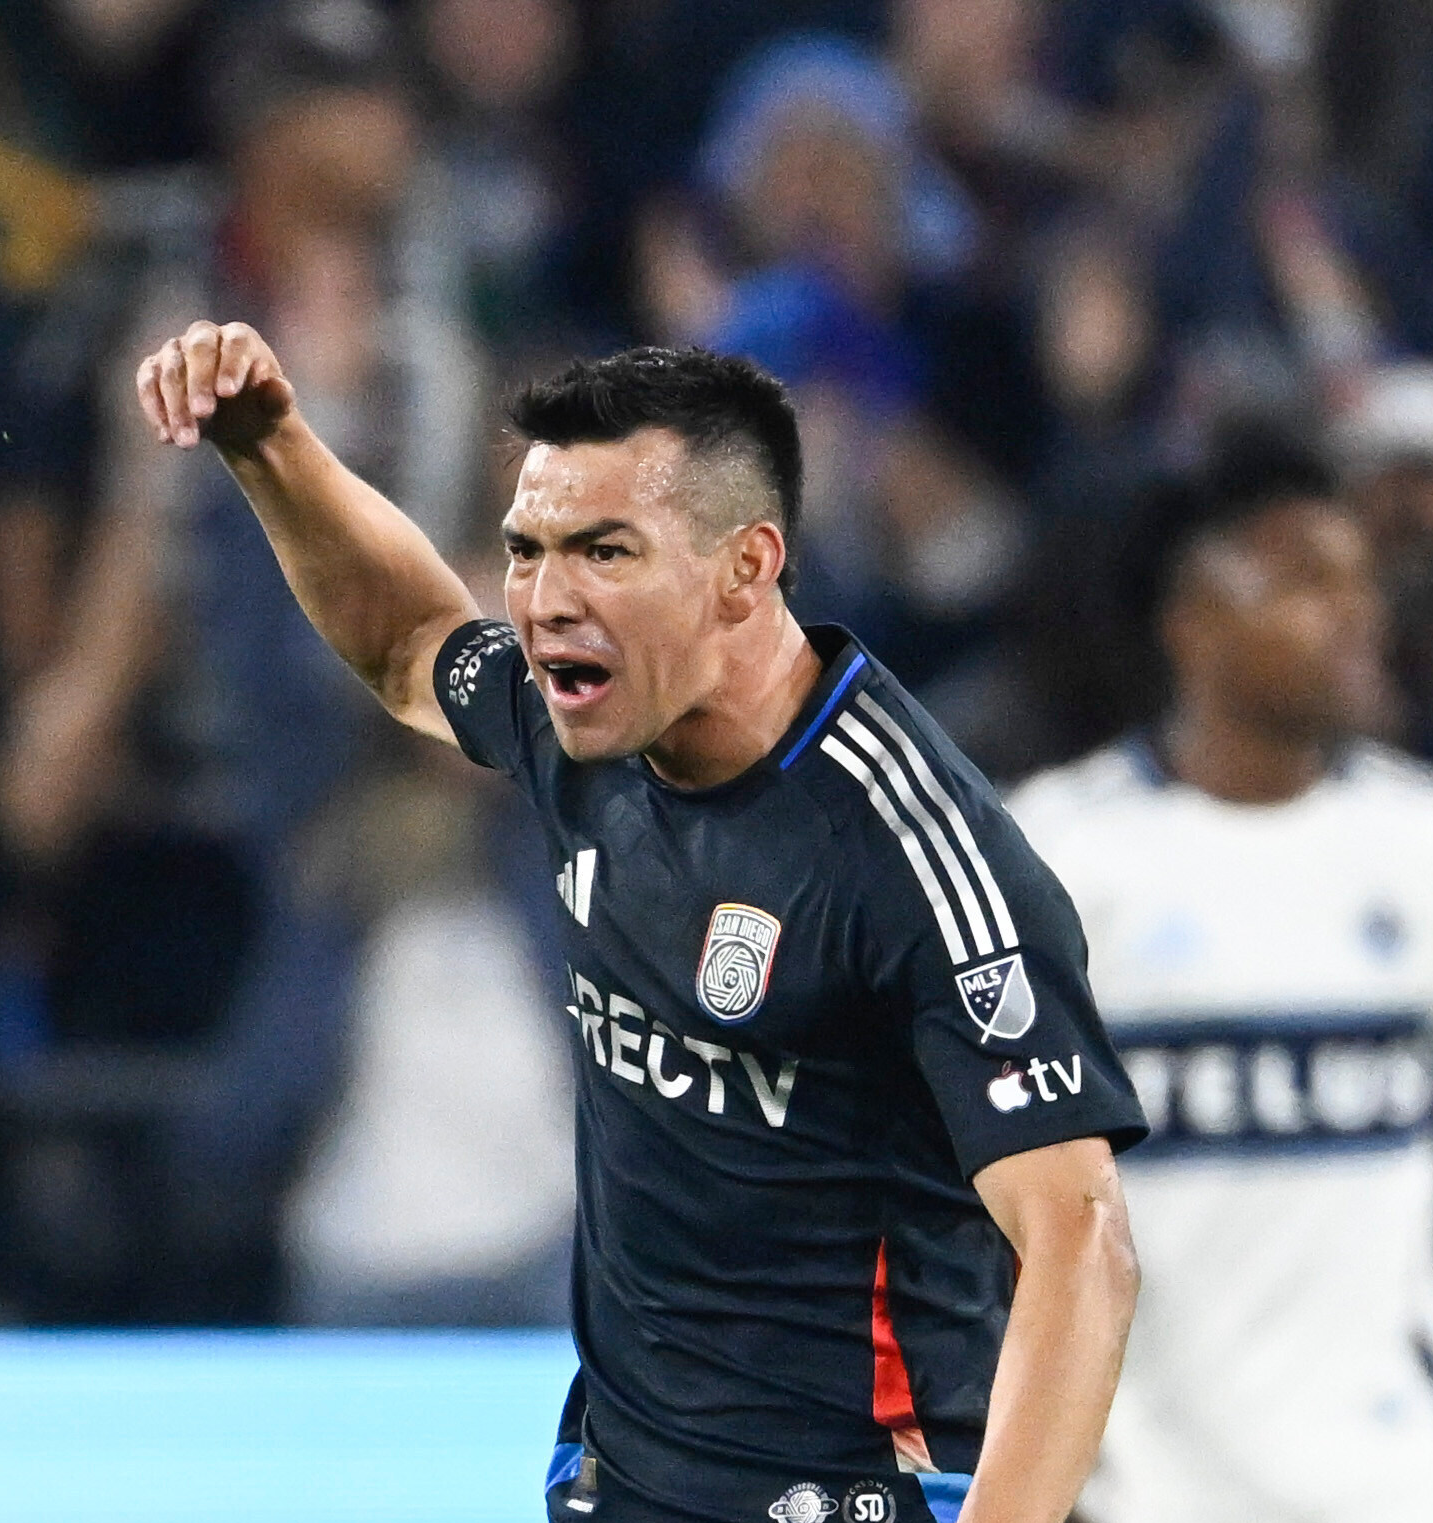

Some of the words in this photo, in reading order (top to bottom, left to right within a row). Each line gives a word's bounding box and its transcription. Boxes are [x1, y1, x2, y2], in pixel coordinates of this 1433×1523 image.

[716, 915, 741, 936] SAN
[739, 918, 772, 948] DIEGO
[963, 968, 1002, 996] MLS
[566, 962, 799, 1128] RECTV
[1027, 1054, 1082, 1102] tv
[854, 1494, 884, 1522] SD
